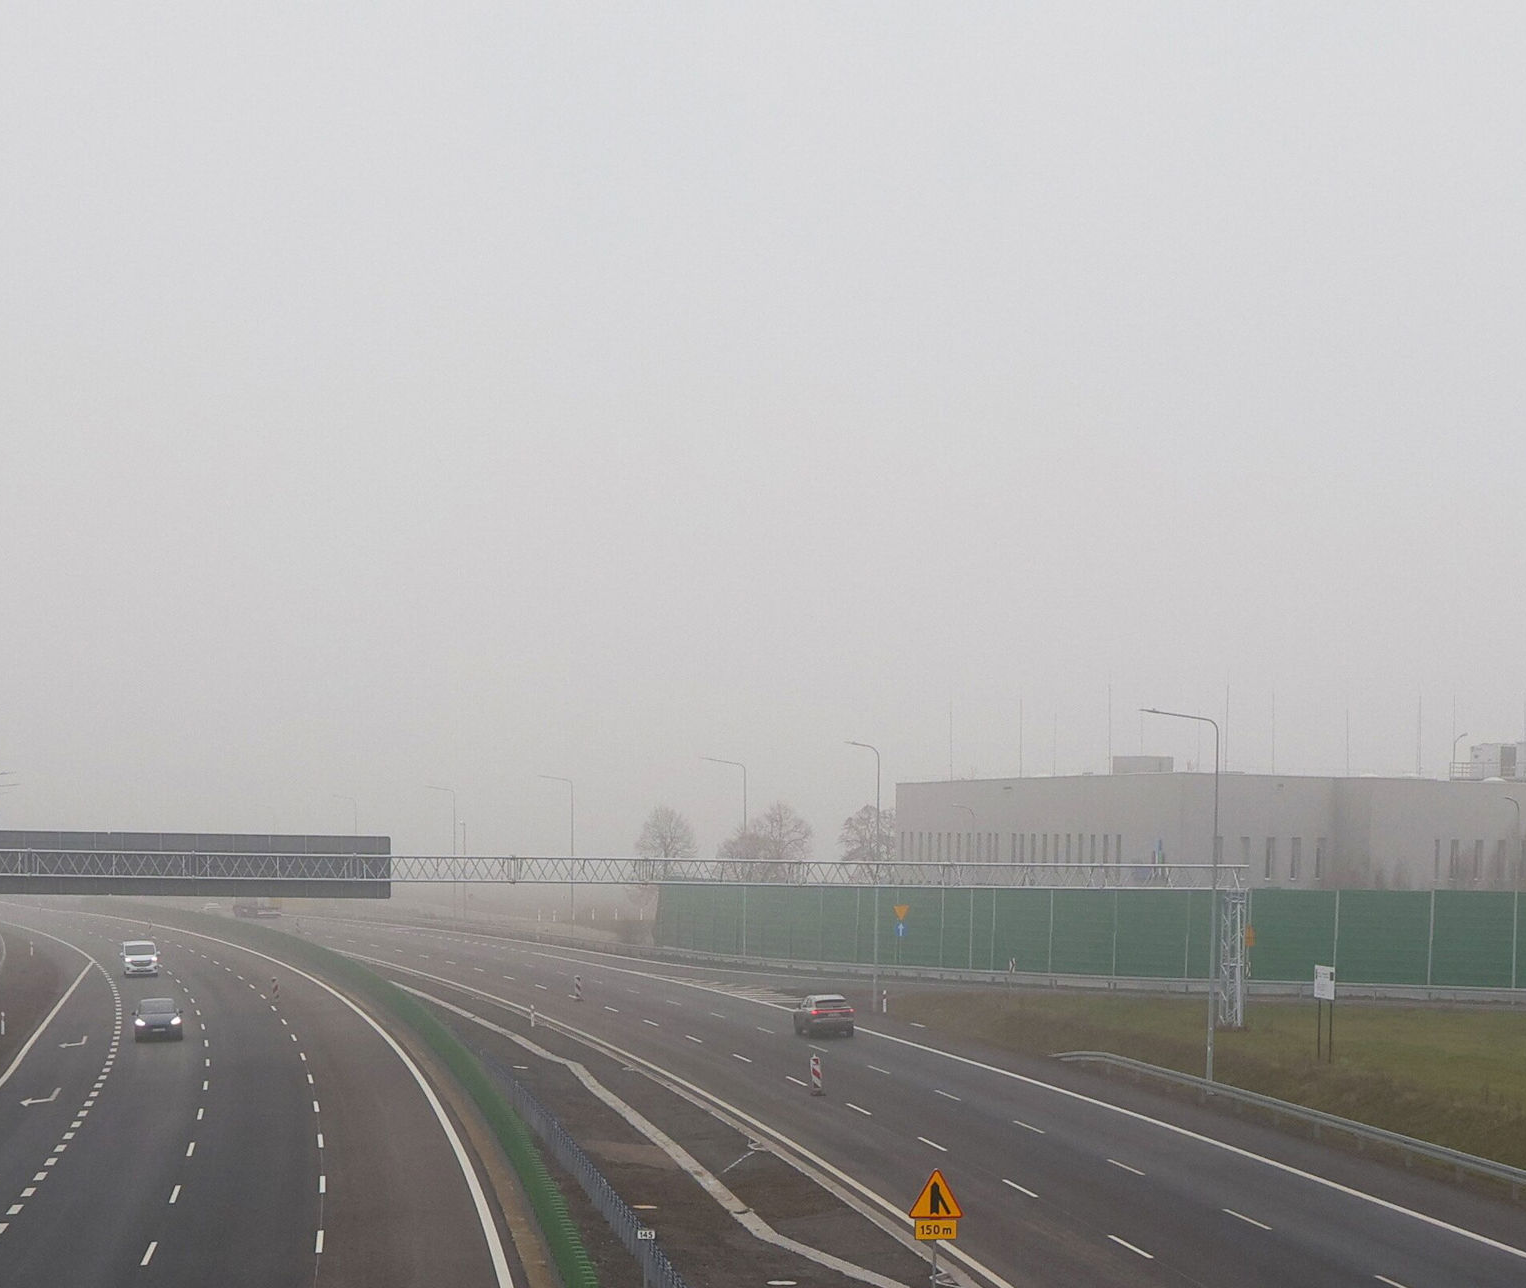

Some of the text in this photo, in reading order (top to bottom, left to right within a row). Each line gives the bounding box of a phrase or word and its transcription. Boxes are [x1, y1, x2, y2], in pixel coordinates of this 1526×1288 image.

[920, 1224, 952, 1235] 150 m
[639, 1231, 653, 1239] 145
